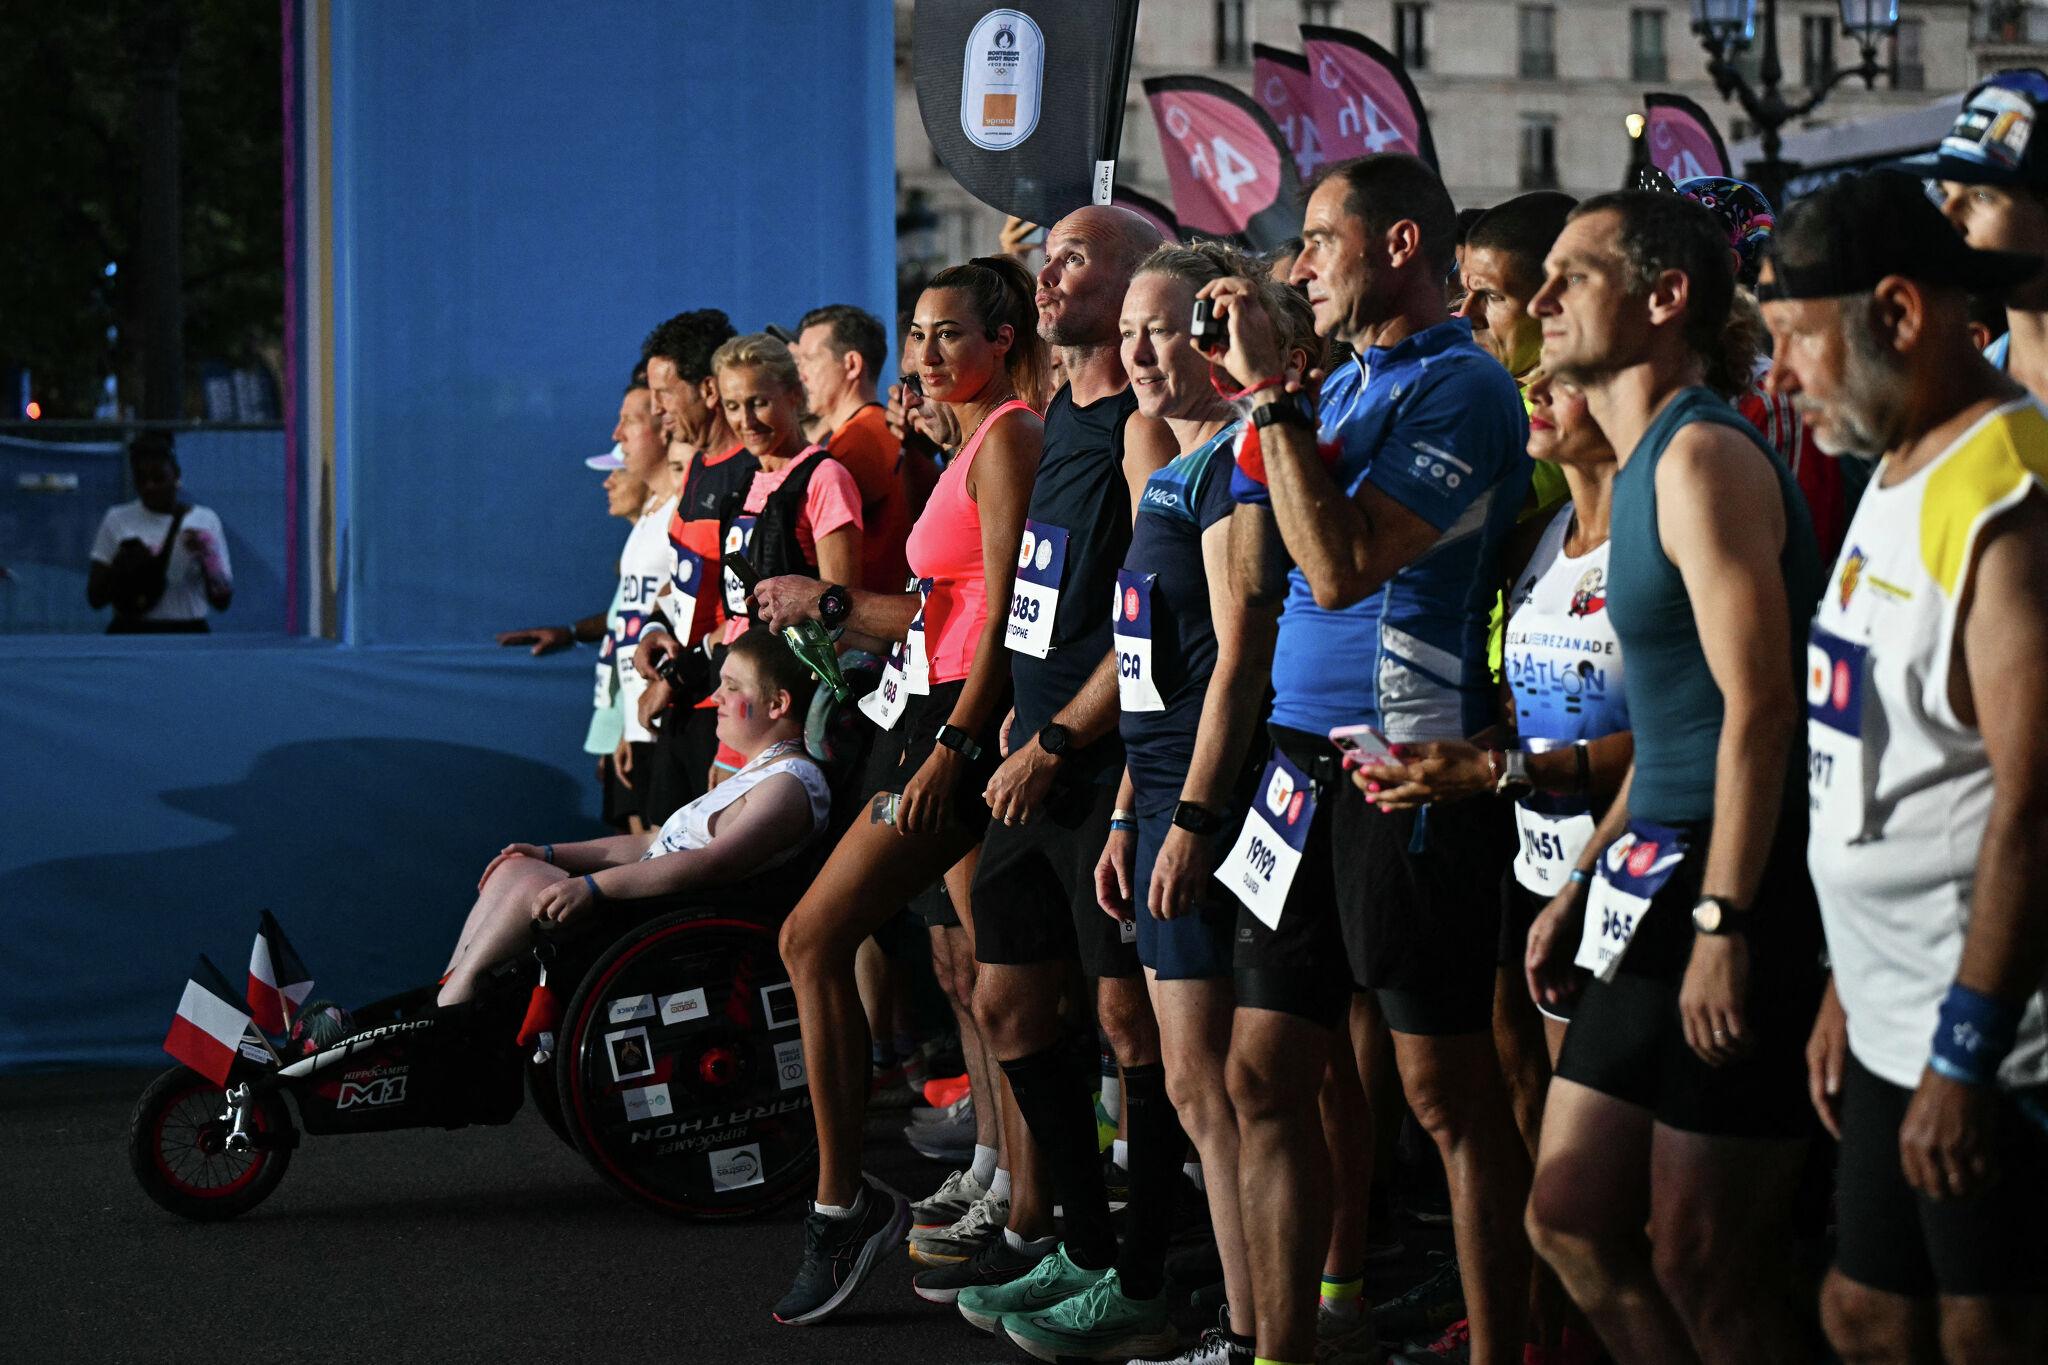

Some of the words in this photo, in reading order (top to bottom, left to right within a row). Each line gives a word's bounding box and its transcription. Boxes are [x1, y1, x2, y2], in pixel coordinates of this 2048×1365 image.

[1246, 836, 1277, 882] 19192
[344, 1065, 409, 1080] HIPPOCAMPE
[336, 1076, 408, 1109] M1
